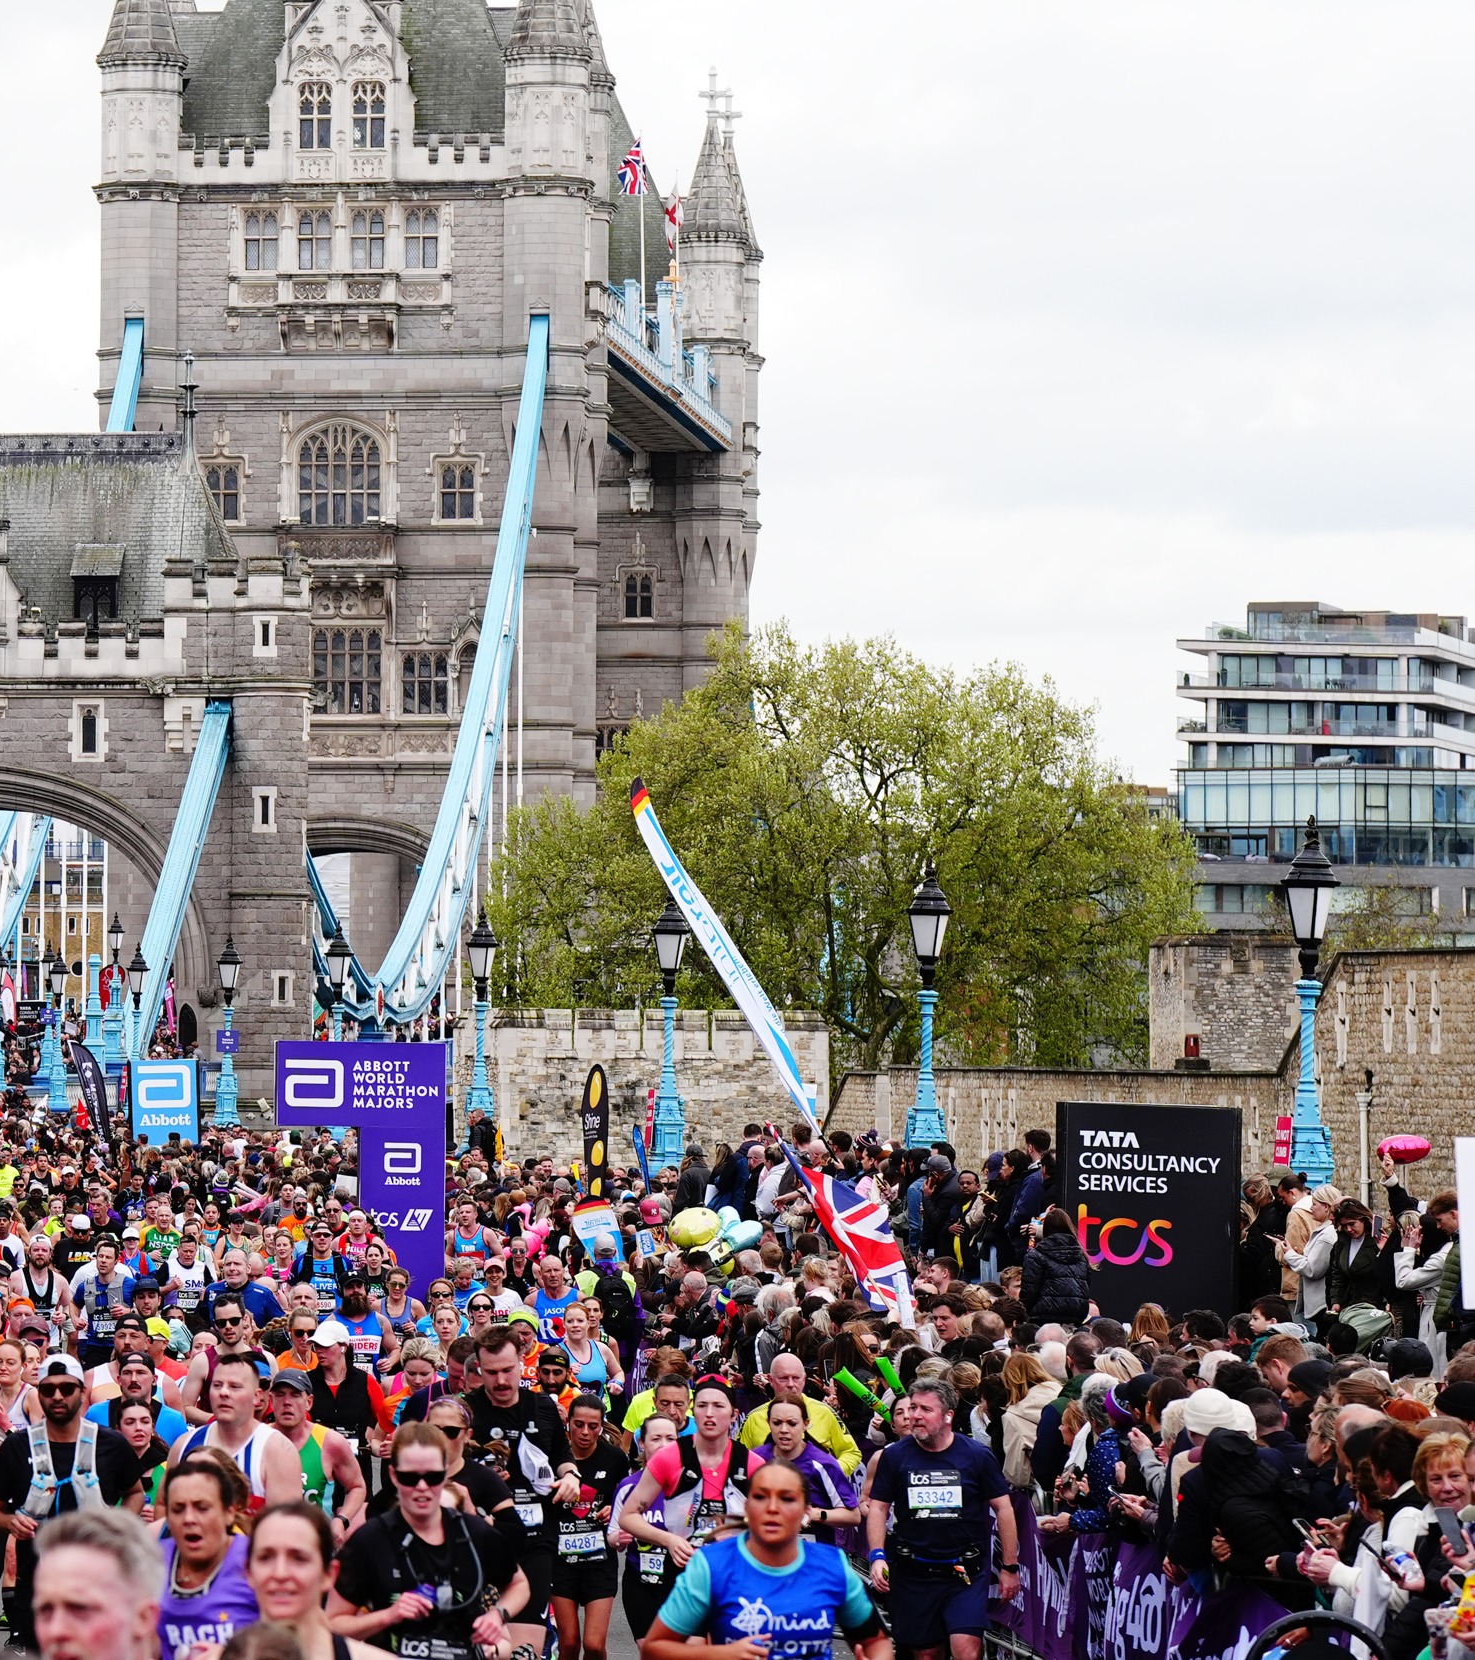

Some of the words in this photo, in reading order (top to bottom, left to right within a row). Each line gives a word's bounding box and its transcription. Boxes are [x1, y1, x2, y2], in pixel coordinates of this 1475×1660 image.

[353, 1060, 410, 1072] ABBOTT
[353, 1072, 406, 1084] WORLD
[353, 1085, 439, 1097] MARATHON
[353, 1097, 414, 1109] MAJORS
[140, 1113, 192, 1127] Abbott
[584, 1113, 602, 1131] Shine
[1079, 1129, 1140, 1148] TATA
[1078, 1151, 1221, 1174] CONSULTANCY
[384, 1176, 421, 1186] Abbott
[1078, 1173, 1168, 1194] SERVICES
[1077, 1203, 1174, 1267] tcs
[910, 1472, 930, 1485] tcs
[917, 1491, 953, 1504] 53342
[559, 1521, 576, 1533] tcs
[564, 1535, 597, 1551] 64287
[769, 1609, 832, 1632] mind
[400, 1637, 429, 1657] tcs
